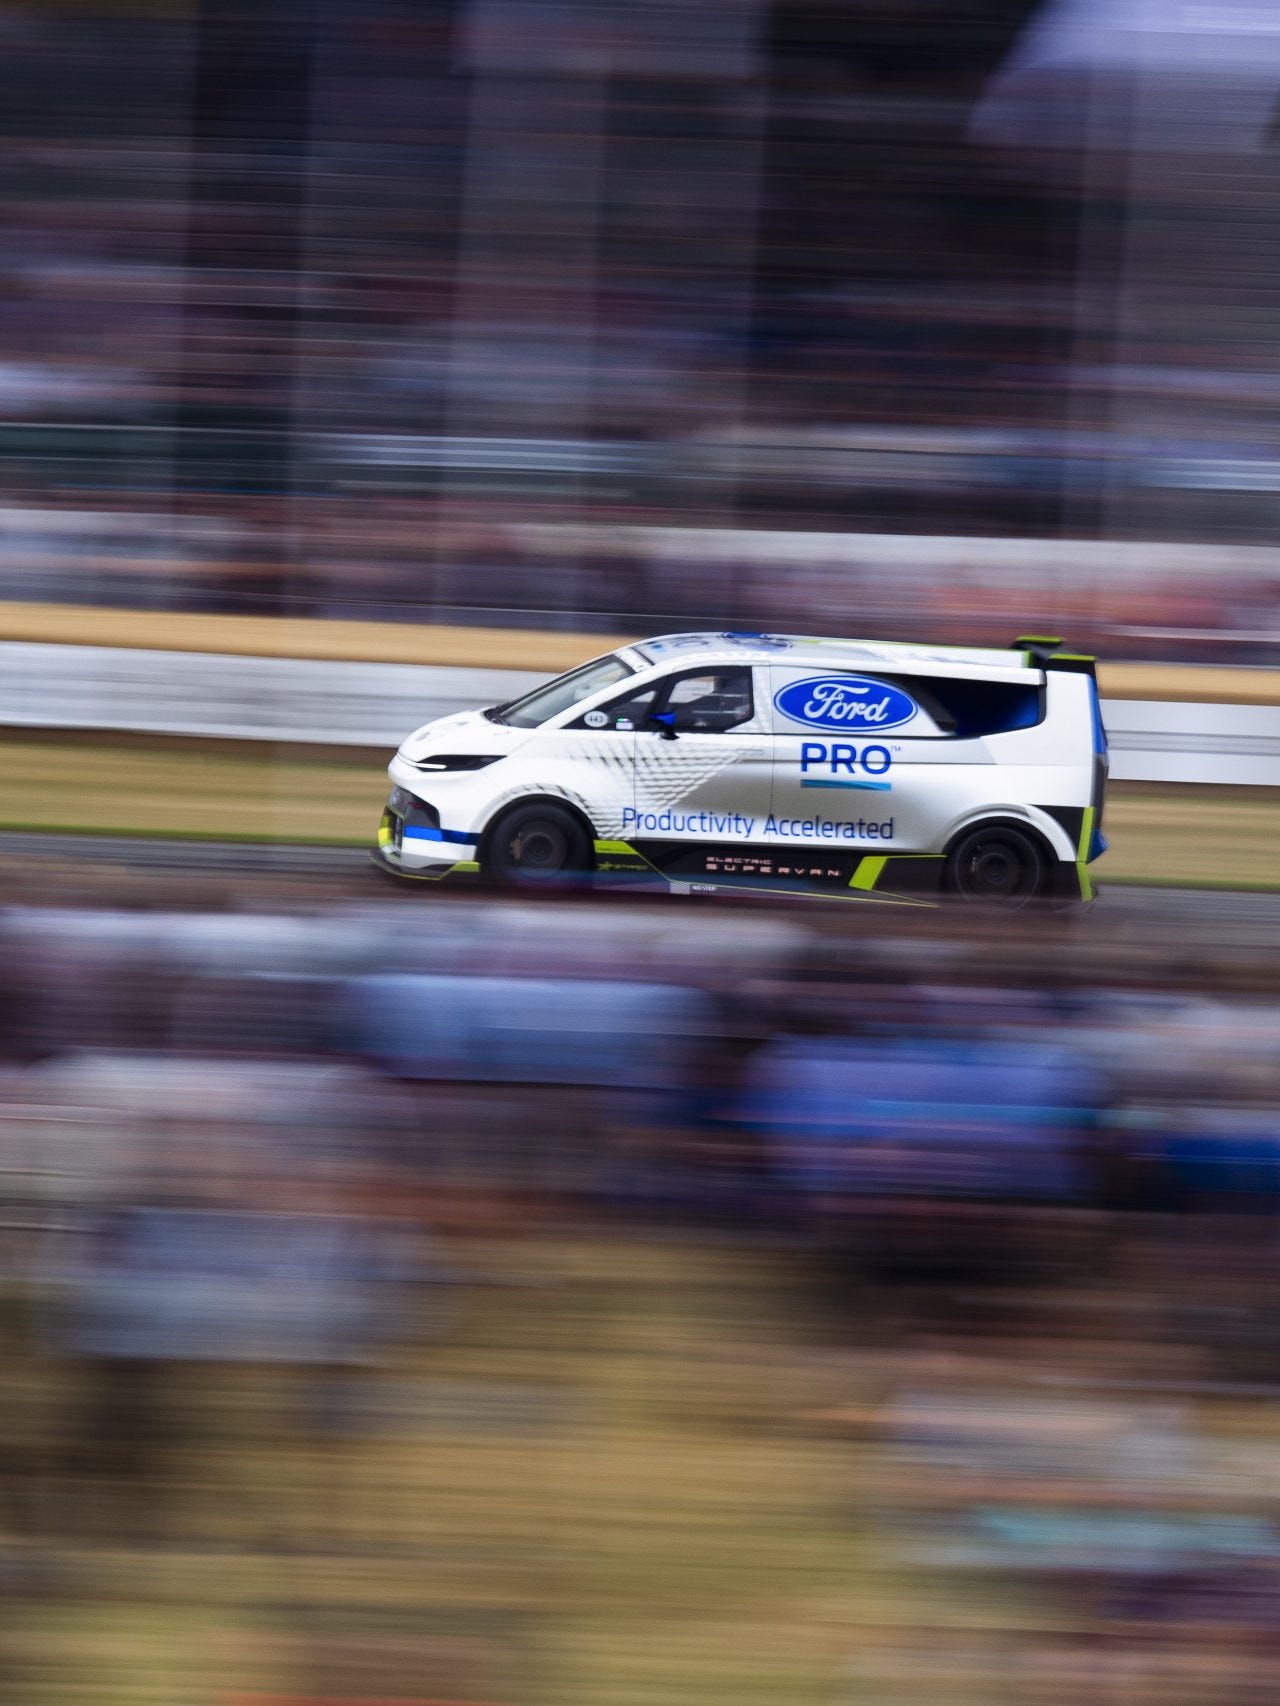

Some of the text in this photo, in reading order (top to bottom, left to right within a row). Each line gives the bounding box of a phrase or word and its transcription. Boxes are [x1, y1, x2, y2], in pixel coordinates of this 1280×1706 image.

[803, 683, 890, 722] Ford
[801, 743, 891, 774] PRO
[622, 808, 895, 839] Productivity Accelerated
[706, 856, 772, 865] ELECTRIC
[706, 863, 841, 876] SUPERVAN
